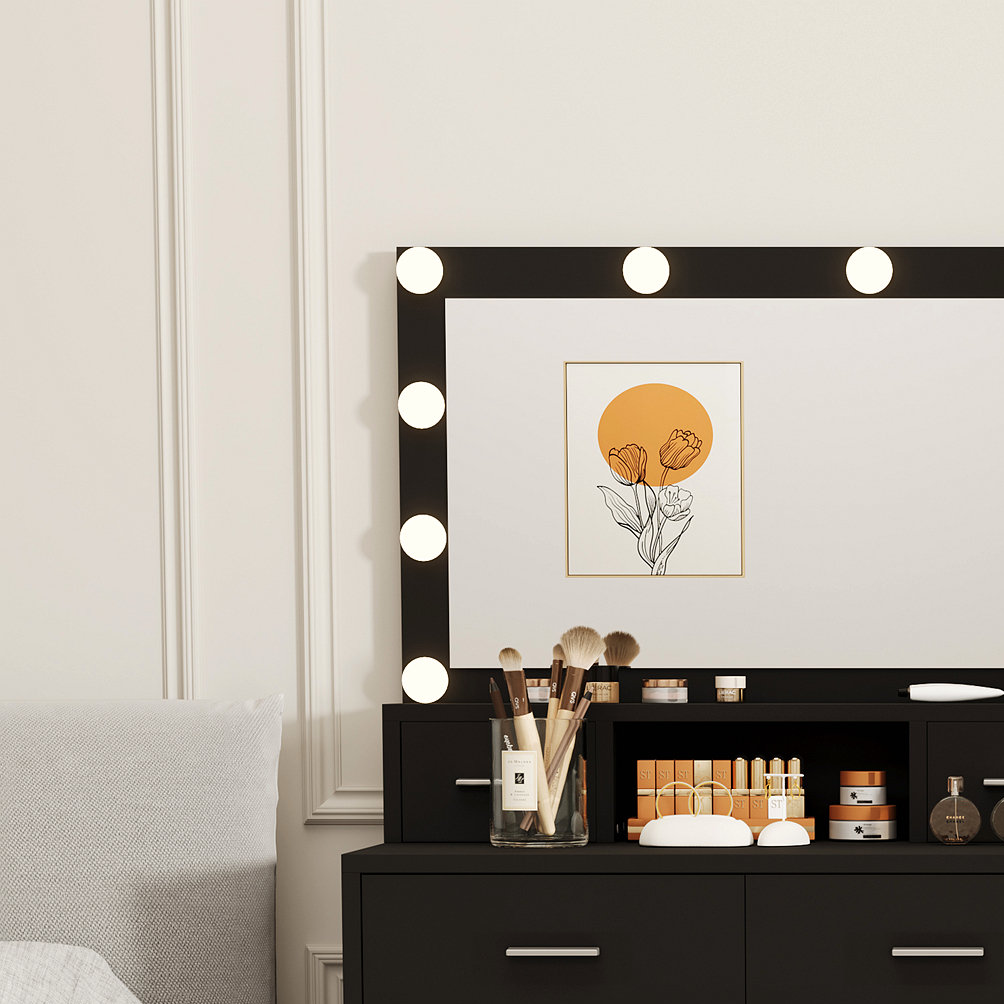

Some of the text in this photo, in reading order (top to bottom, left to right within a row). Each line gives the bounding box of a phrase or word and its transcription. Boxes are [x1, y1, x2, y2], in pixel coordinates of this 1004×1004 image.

[640, 769, 651, 779] ST
[659, 769, 670, 779] ST
[678, 769, 689, 779] ST
[716, 769, 727, 779] ST
[734, 800, 745, 808] ST
[752, 800, 764, 808] ST
[771, 800, 782, 808] ST
